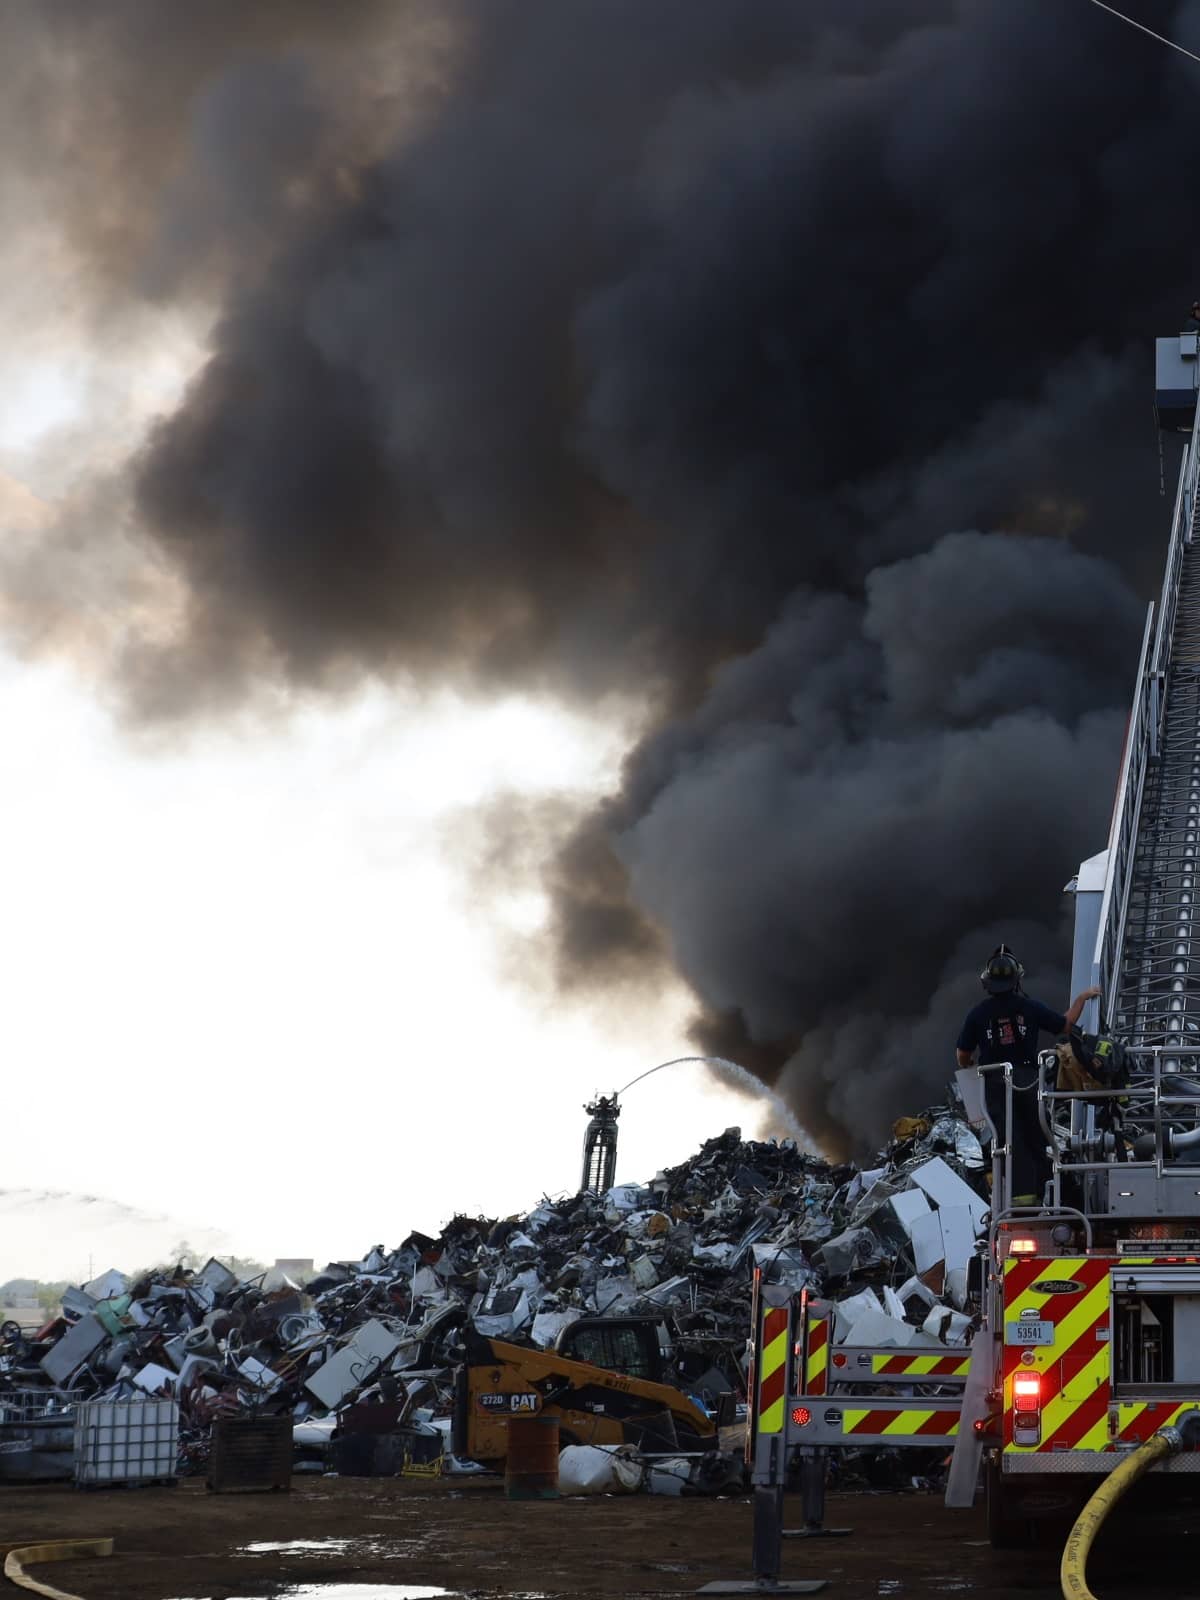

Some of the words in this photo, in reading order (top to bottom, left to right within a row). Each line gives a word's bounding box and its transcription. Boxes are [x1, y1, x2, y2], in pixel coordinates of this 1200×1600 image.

[1041, 1281, 1073, 1292] Pierce
[1017, 1327, 1042, 1339] 53541
[482, 1395, 503, 1405] 272D
[510, 1394, 537, 1411] CAT
